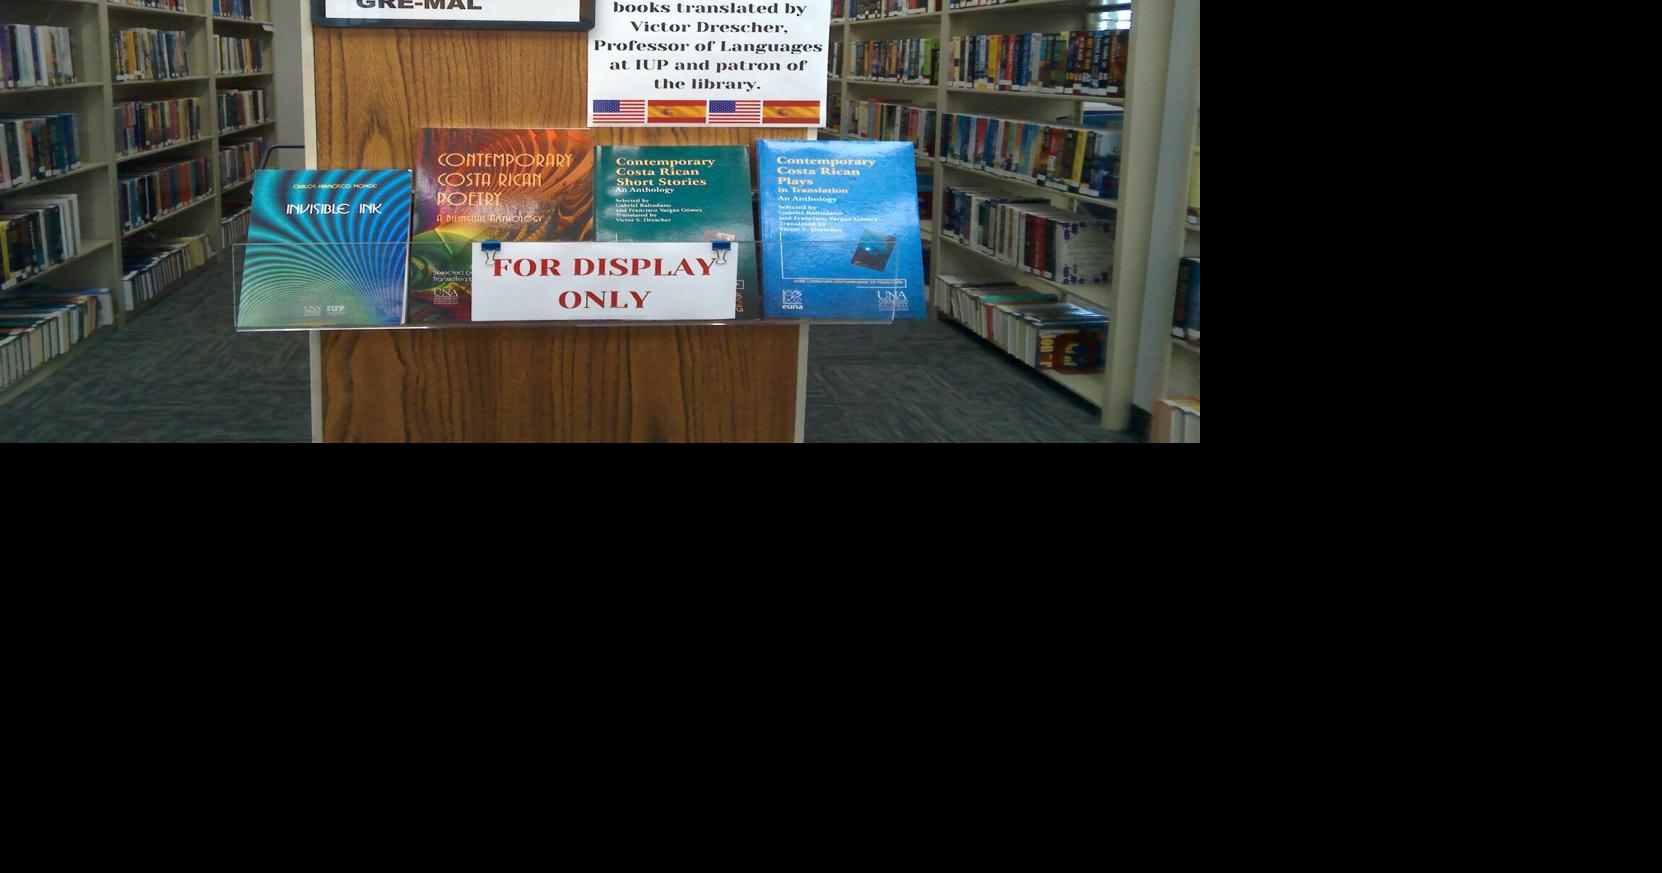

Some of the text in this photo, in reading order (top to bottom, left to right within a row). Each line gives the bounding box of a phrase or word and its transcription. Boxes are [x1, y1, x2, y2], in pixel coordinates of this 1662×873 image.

[356, 0, 483, 10] GRE-MAL
[613, 1, 808, 17] books translated by
[630, 20, 789, 35] Victor Drescher,
[594, 39, 823, 55] Professor of Languages
[609, 59, 808, 73] at IUP and patron of
[654, 78, 761, 92] the library.
[437, 152, 573, 168] CONTEMPORARY
[616, 157, 716, 168] Contemporary
[777, 156, 876, 168] Contemporary
[616, 167, 700, 176] Costa Rican
[777, 166, 860, 176] Costa Rican
[437, 172, 542, 187] COSTA RICAN
[616, 177, 707, 186] Short Stories
[777, 176, 814, 188] Plays
[791, 186, 849, 194] Translation
[436, 191, 502, 207] POETRY
[792, 196, 838, 204] Anthology
[286, 203, 383, 215] INVISIBLE INK
[492, 257, 718, 277] FOR DISPLAY
[433, 288, 459, 297] UNA
[877, 290, 907, 300] UNA
[558, 290, 652, 310] ONLY
